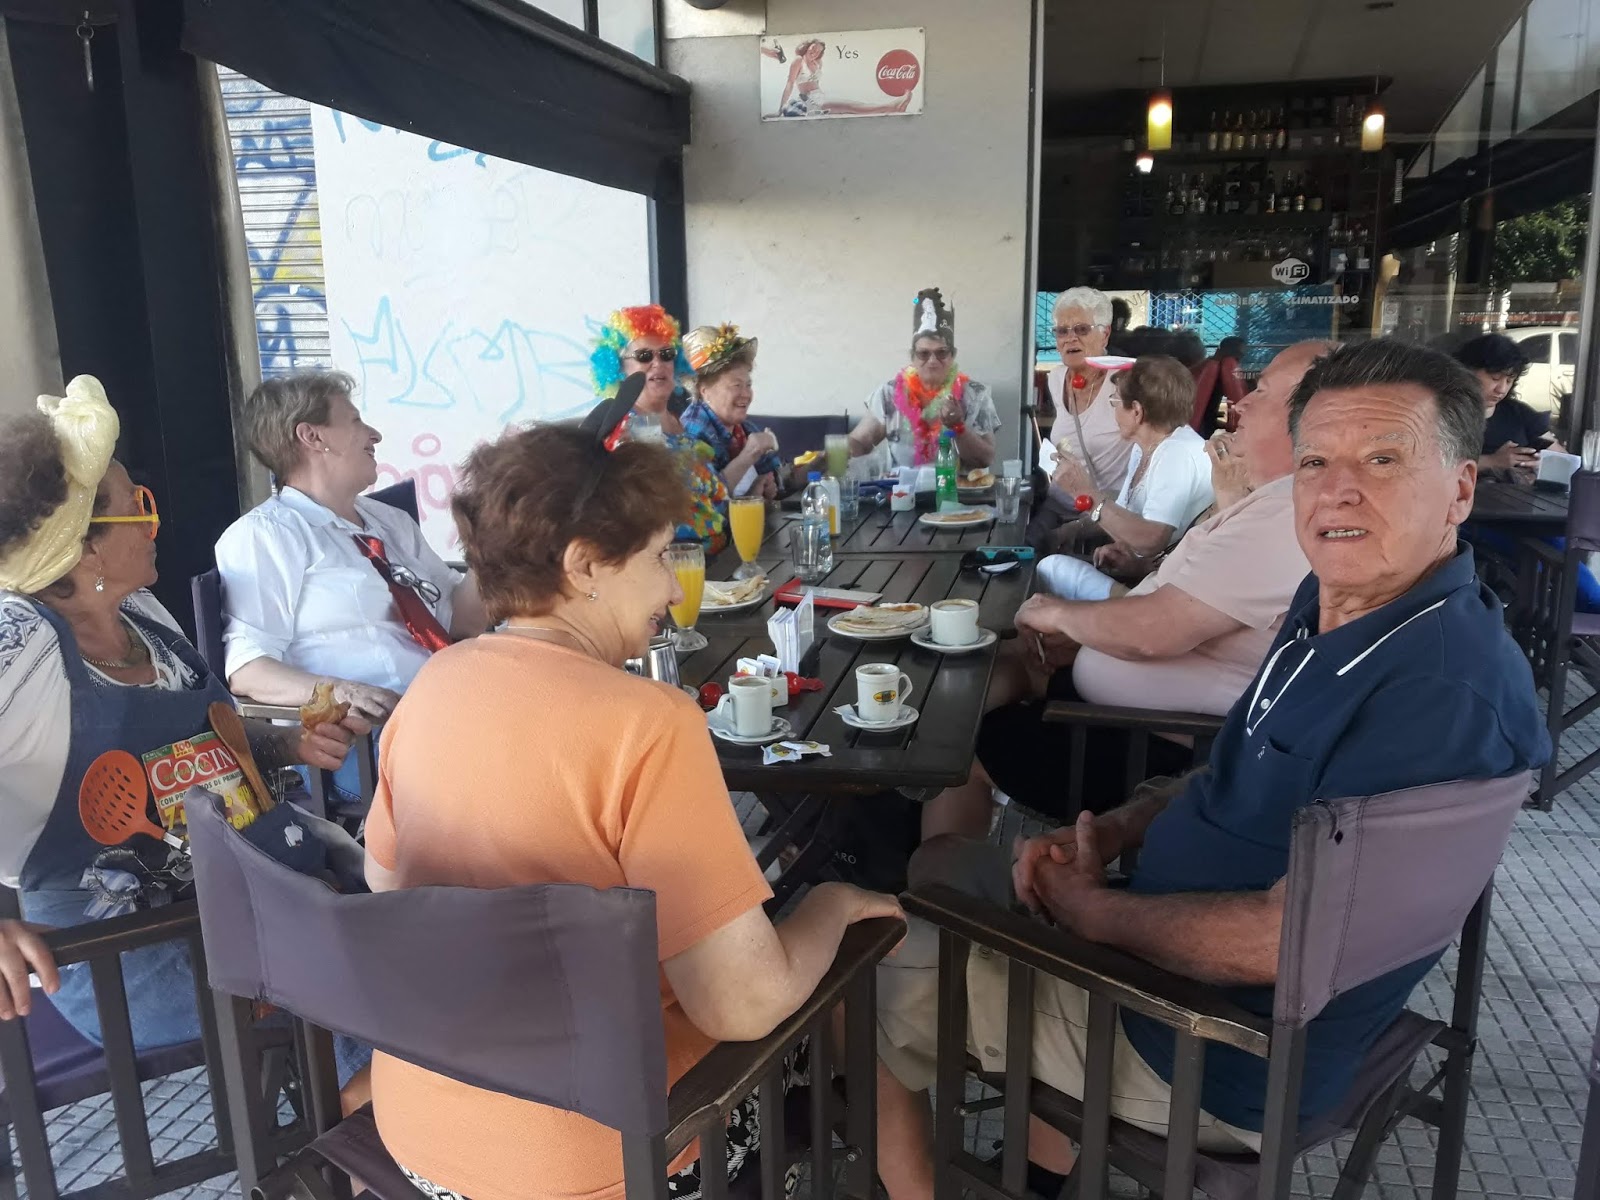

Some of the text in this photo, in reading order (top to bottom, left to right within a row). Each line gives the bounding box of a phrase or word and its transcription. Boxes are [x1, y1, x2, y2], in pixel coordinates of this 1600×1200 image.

[836, 45, 859, 59] Yes
[1284, 295, 1359, 305] CLIMATIZADO
[174, 740, 191, 753] 100
[151, 745, 237, 791] COCIN
[160, 796, 174, 806] CON
